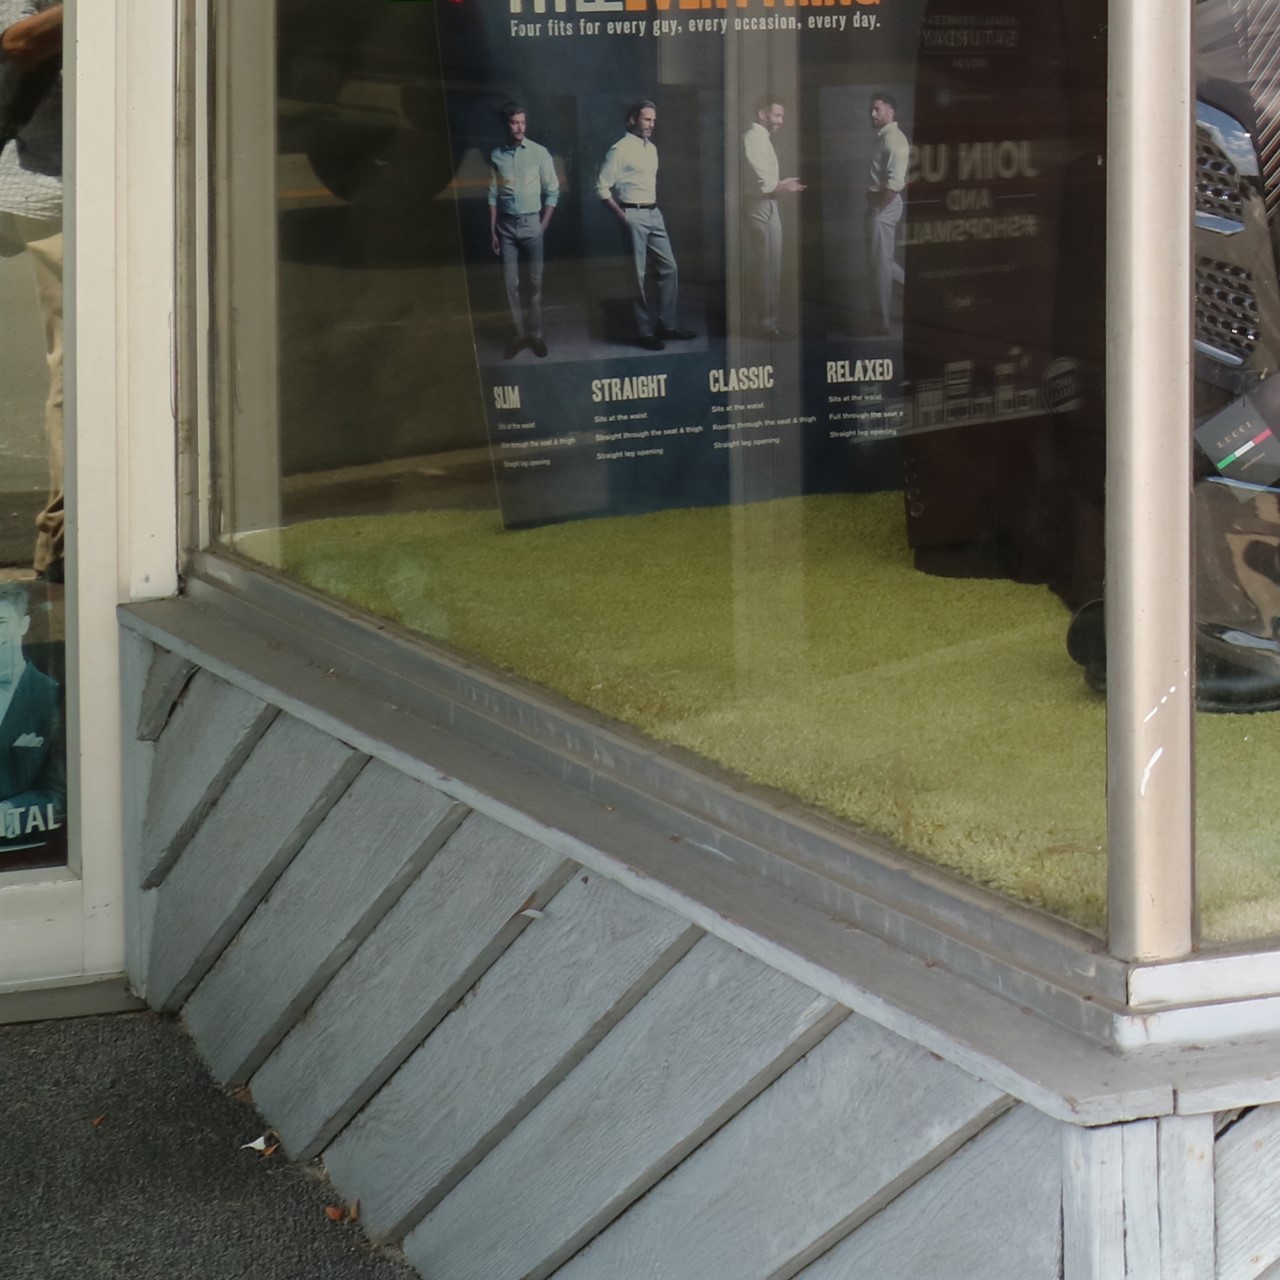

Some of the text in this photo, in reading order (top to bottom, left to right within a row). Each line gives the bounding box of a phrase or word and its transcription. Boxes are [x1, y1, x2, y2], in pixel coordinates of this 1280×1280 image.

[511, 11, 881, 37] Four fits for every guy, every occasion, every day.
[708, 365, 774, 392] CLASSIC
[826, 358, 894, 383] RELAXED
[493, 385, 521, 409] SLIM
[591, 373, 668, 402] STRAIGHT
